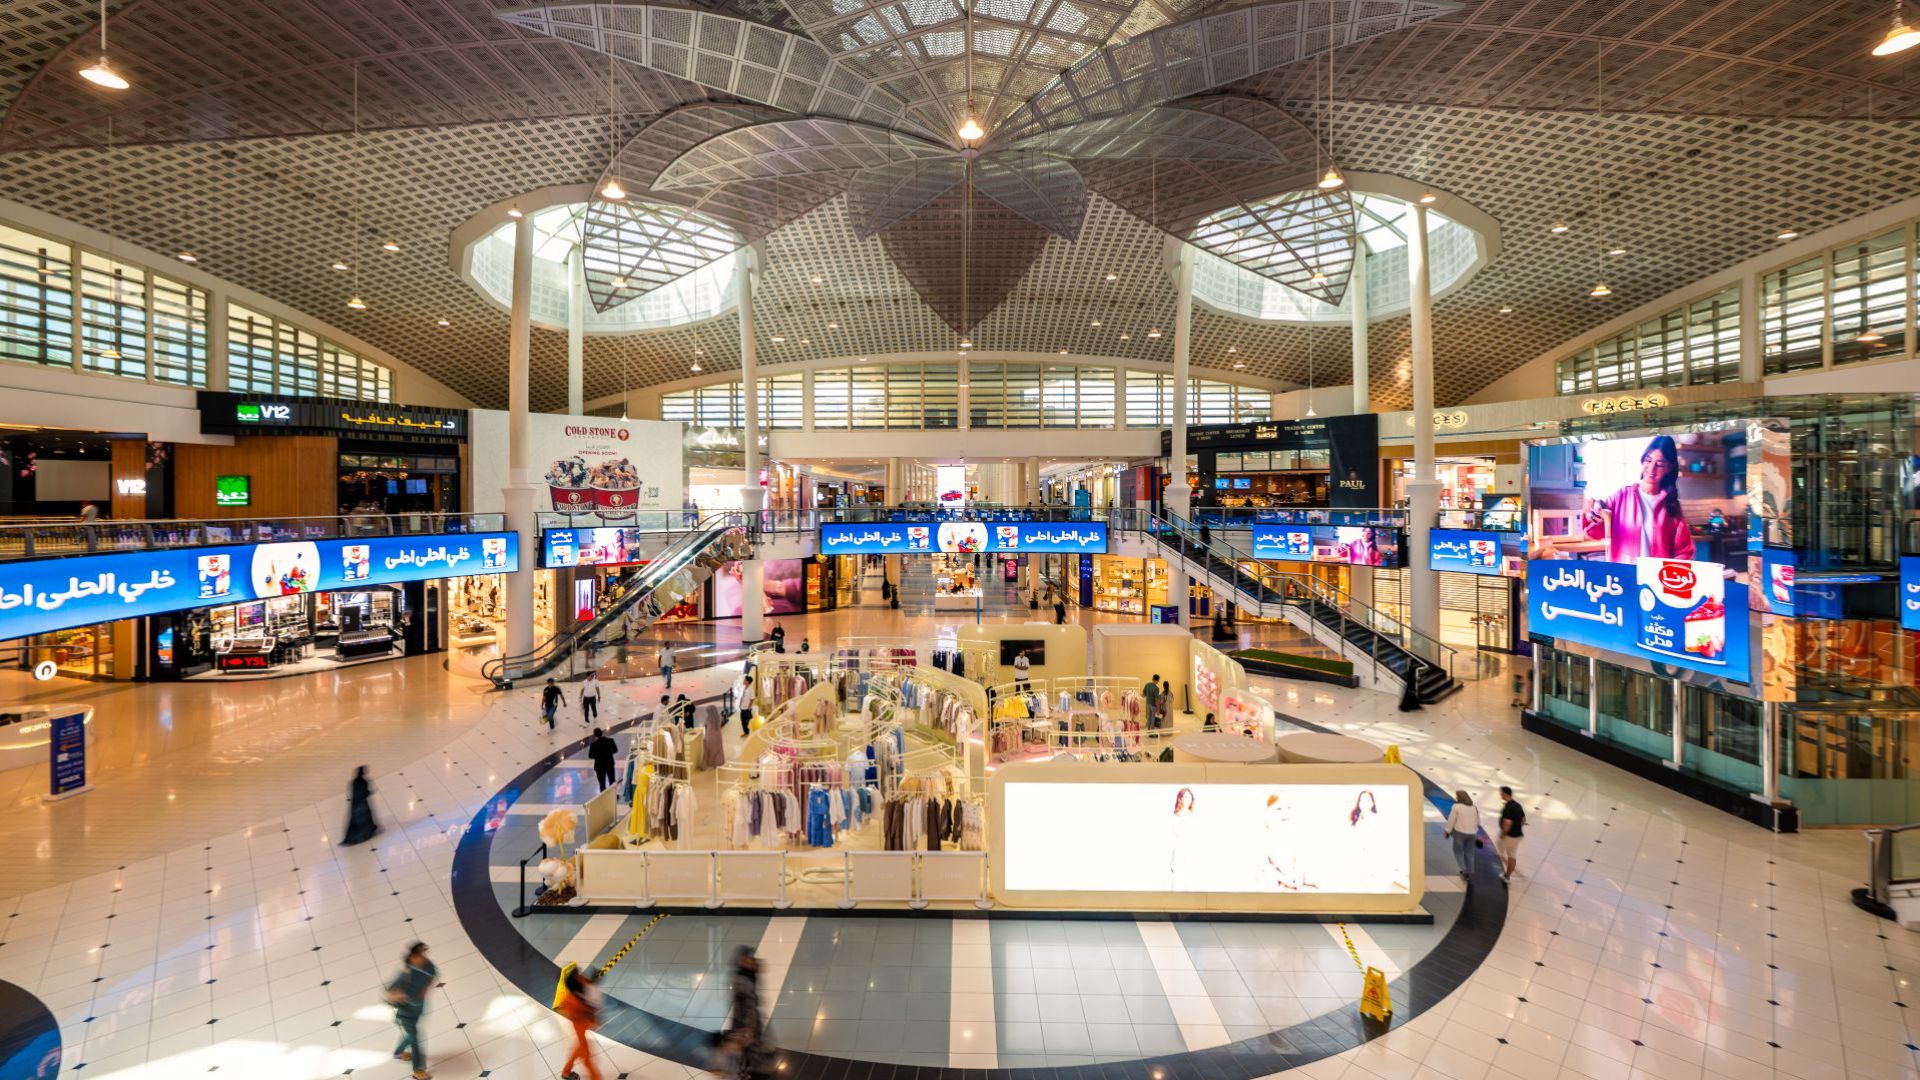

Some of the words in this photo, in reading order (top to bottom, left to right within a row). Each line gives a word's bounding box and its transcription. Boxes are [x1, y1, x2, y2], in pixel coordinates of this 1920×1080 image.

[260, 405, 290, 419] V12
[1592, 398, 1659, 412] FACES
[397, 415, 442, 430] كيف
[565, 425, 587, 436] COLD
[589, 426, 616, 439] STONE
[116, 479, 147, 494] V12
[1339, 480, 1366, 489] PAUL
[828, 533, 853, 546] احلى
[853, 531, 880, 545] الحلى
[881, 532, 901, 546] خلي
[1025, 531, 1050, 544] احلى
[1051, 531, 1078, 544] الحلى
[1079, 532, 1100, 546] خلي
[384, 549, 415, 569] احلى
[416, 546, 447, 567] الحلى
[448, 547, 471, 567] خلي
[1542, 567, 1585, 592] الحلى
[1662, 569, 1694, 589] لونا
[36, 572, 115, 611] الحلى
[118, 570, 176, 603] خلي
[1586, 574, 1624, 602] خلي
[0, 583, 33, 610] اح
[1644, 621, 1674, 637] مكثف
[1645, 634, 1673, 648] محلى
[244, 656, 267, 667] YSL
